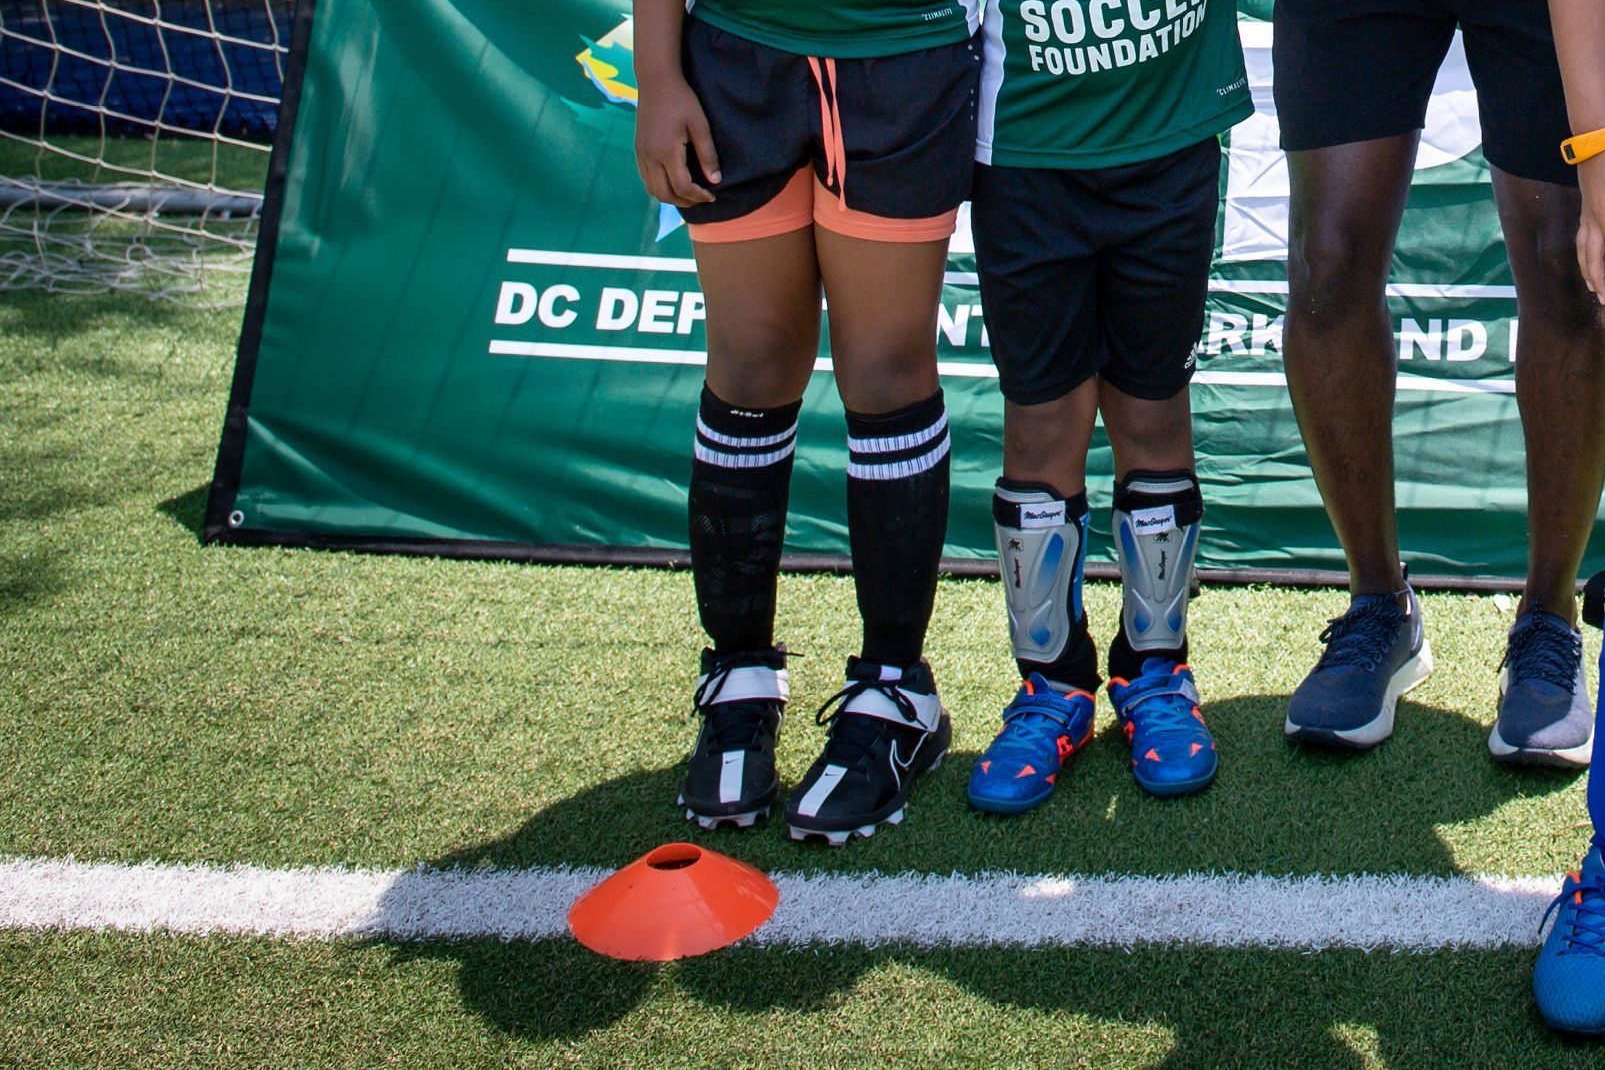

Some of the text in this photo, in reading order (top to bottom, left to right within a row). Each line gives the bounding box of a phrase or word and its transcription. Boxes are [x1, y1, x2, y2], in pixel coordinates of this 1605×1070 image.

[1028, 0, 1209, 76] FOUNDATION
[494, 280, 581, 329] DC
[595, 286, 708, 336] DEP
[1399, 318, 1488, 361] ND
